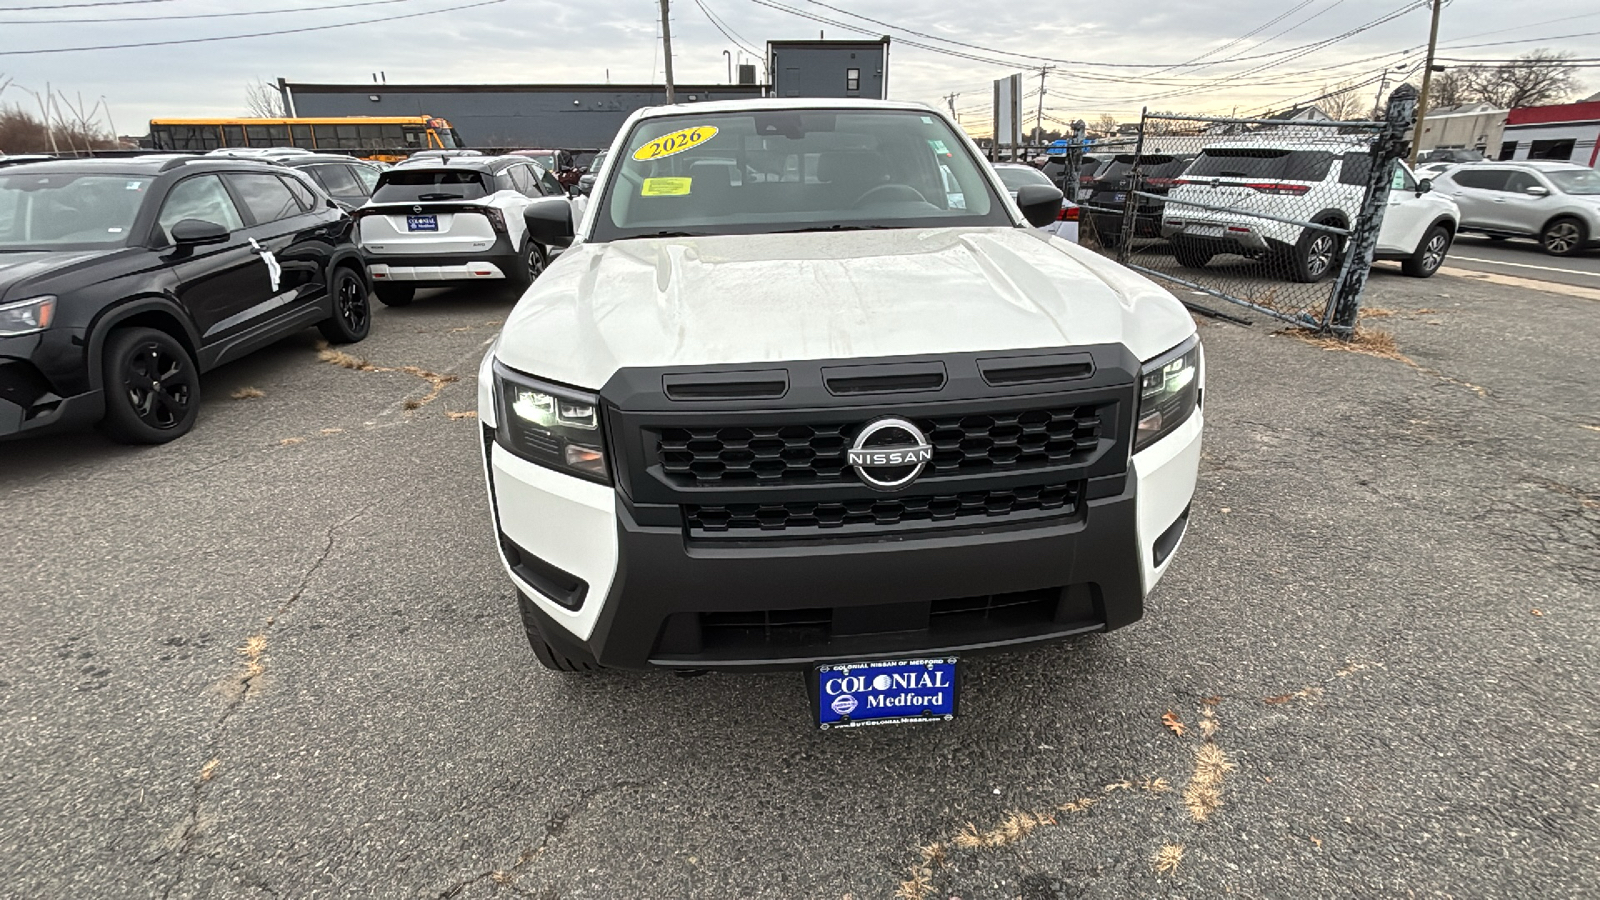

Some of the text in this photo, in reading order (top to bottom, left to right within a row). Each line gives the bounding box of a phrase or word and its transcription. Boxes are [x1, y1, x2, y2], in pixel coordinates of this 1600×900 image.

[650, 128, 701, 157] 2026
[849, 449, 930, 464] NISSAN
[833, 663, 868, 671] COLONIAL
[826, 671, 949, 695] COLONIAL
[866, 692, 943, 708] Medford
